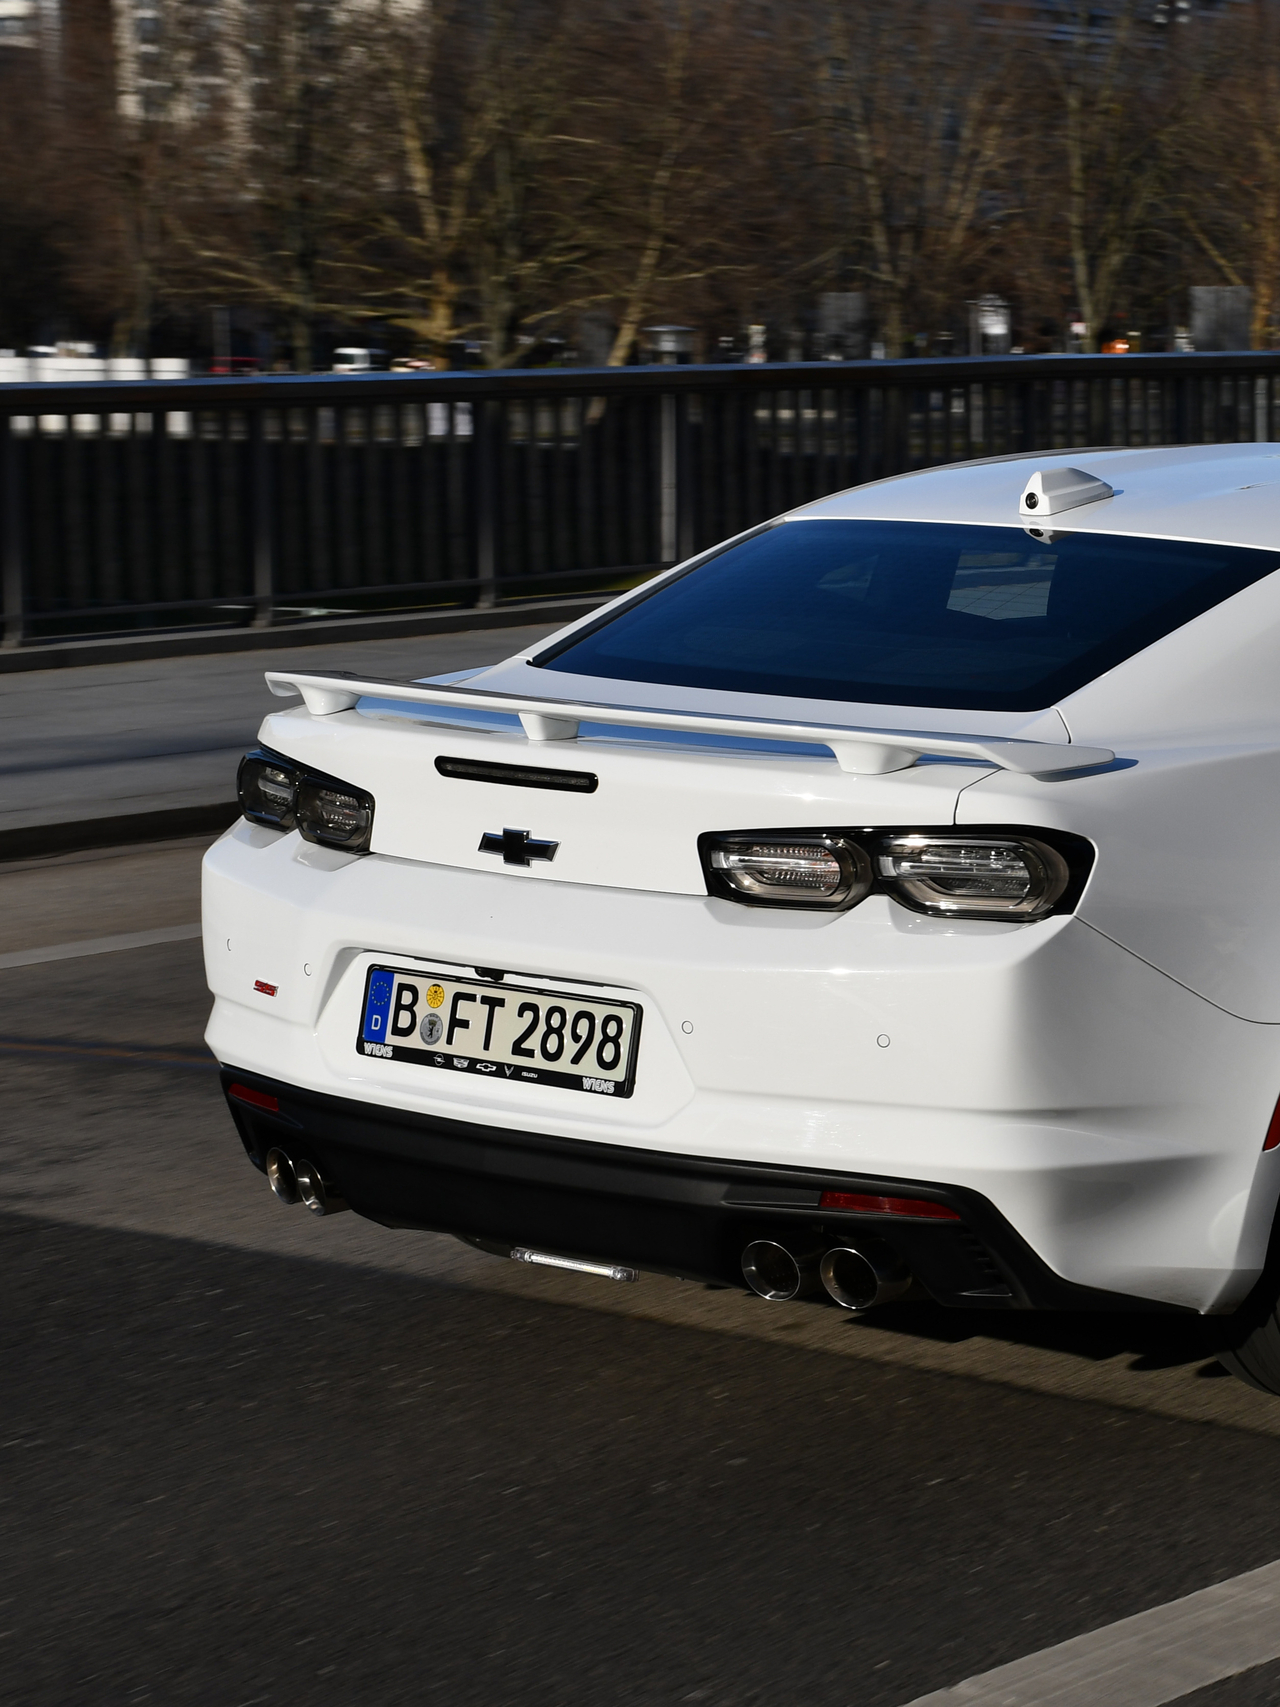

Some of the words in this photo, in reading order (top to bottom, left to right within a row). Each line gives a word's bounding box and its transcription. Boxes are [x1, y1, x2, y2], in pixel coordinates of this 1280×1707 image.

[371, 1014, 381, 1031] D
[390, 982, 419, 1038] B
[445, 991, 506, 1052] FT
[511, 1001, 624, 1071] 2898
